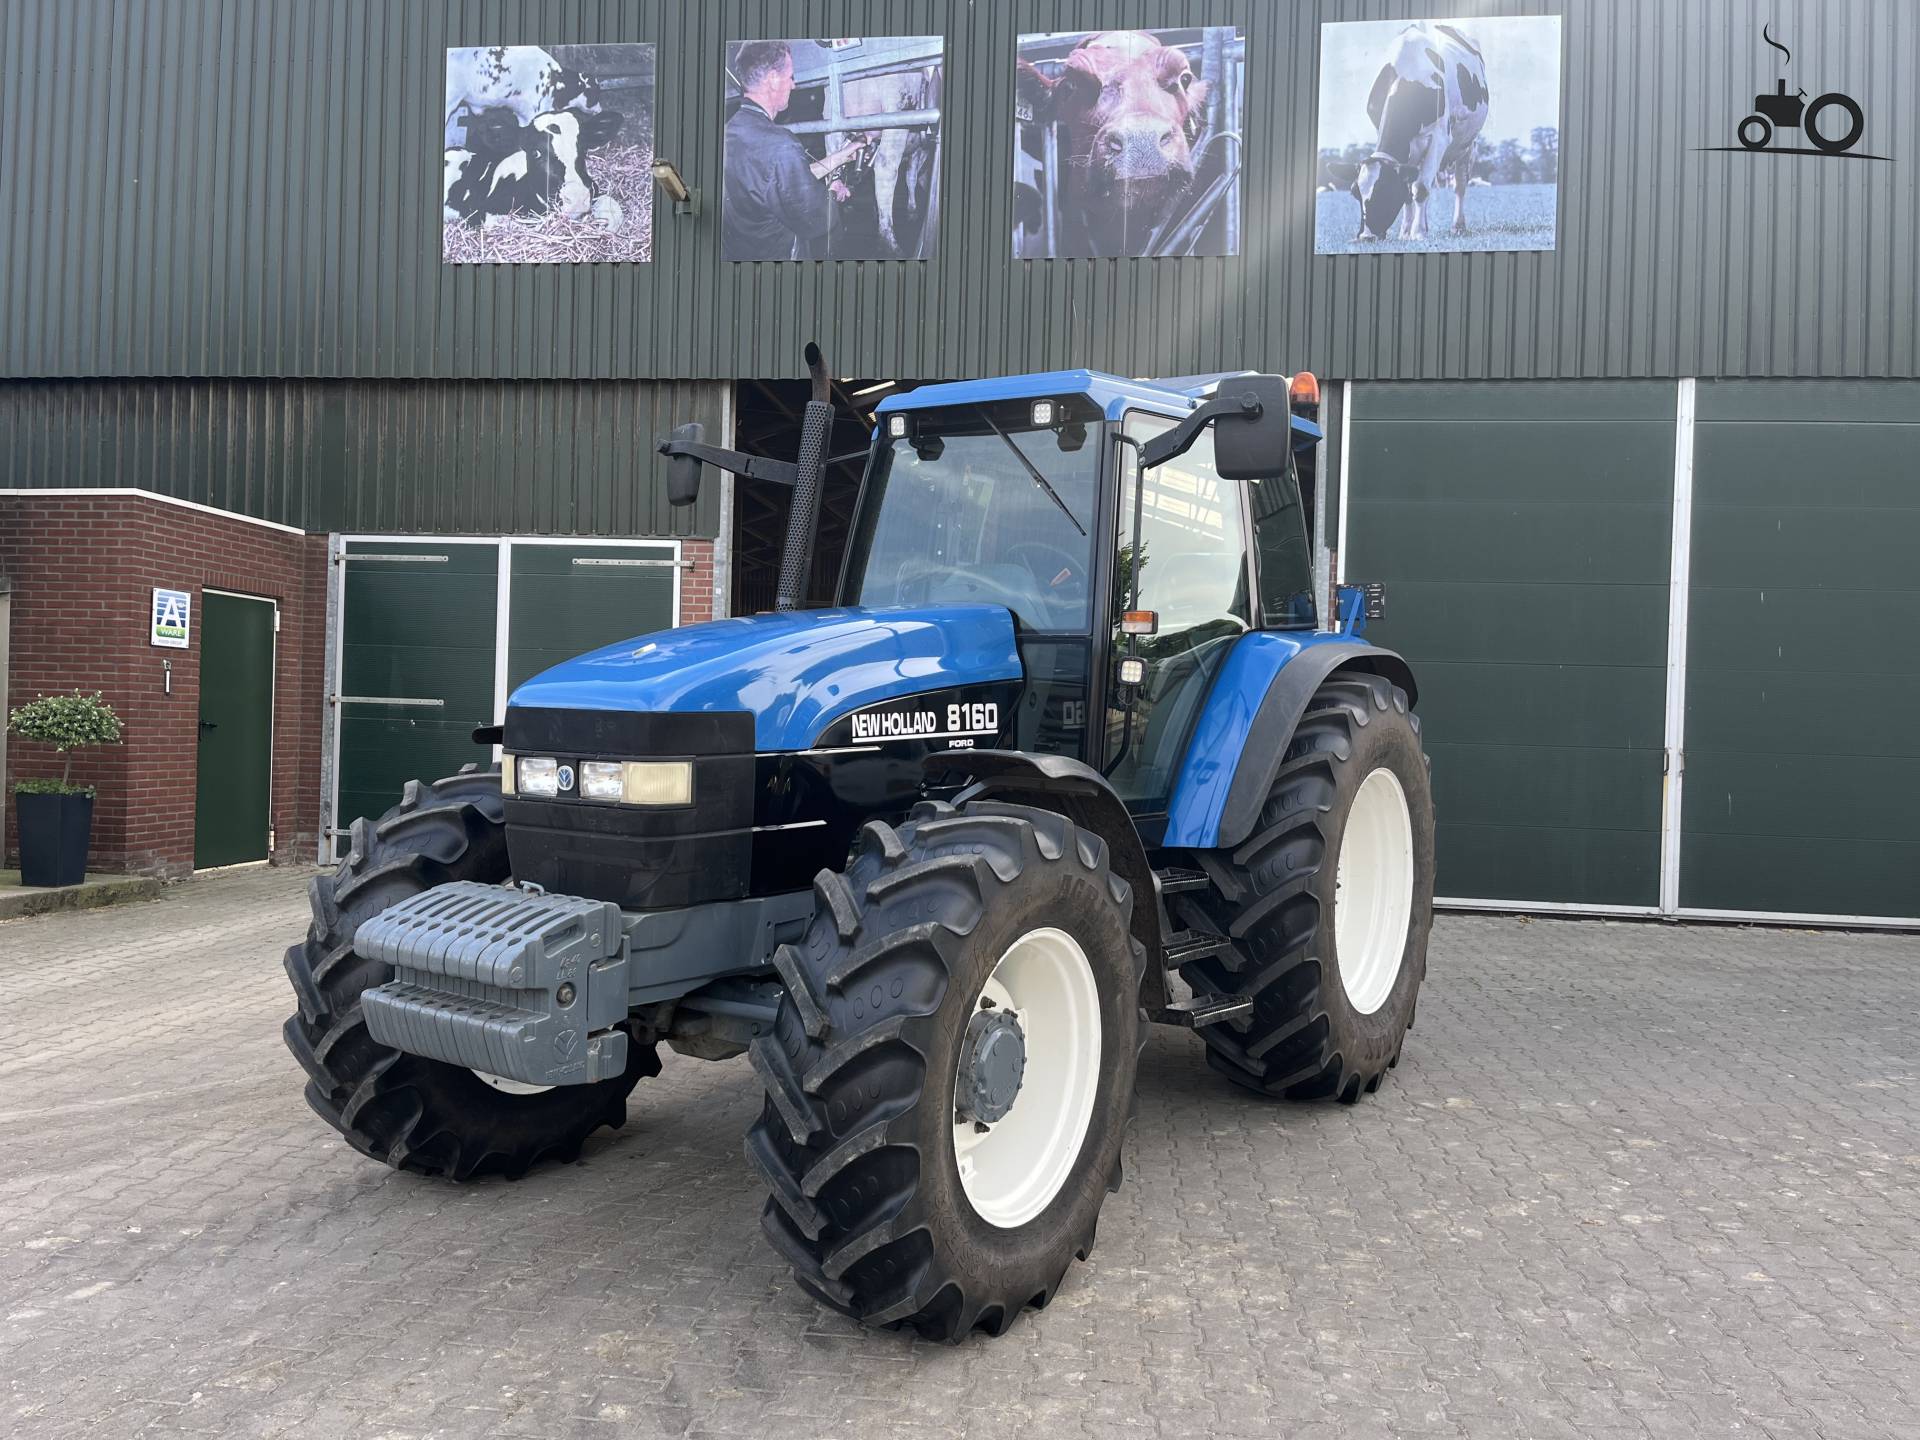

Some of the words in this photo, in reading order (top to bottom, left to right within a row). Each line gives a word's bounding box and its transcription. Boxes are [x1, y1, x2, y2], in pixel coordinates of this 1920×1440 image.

[160, 597, 183, 628] A
[160, 628, 183, 637] WARE
[852, 713, 881, 737] NEW
[882, 711, 937, 736] HOLLAND
[947, 703, 998, 731] 8160
[949, 739, 974, 748] FORD
